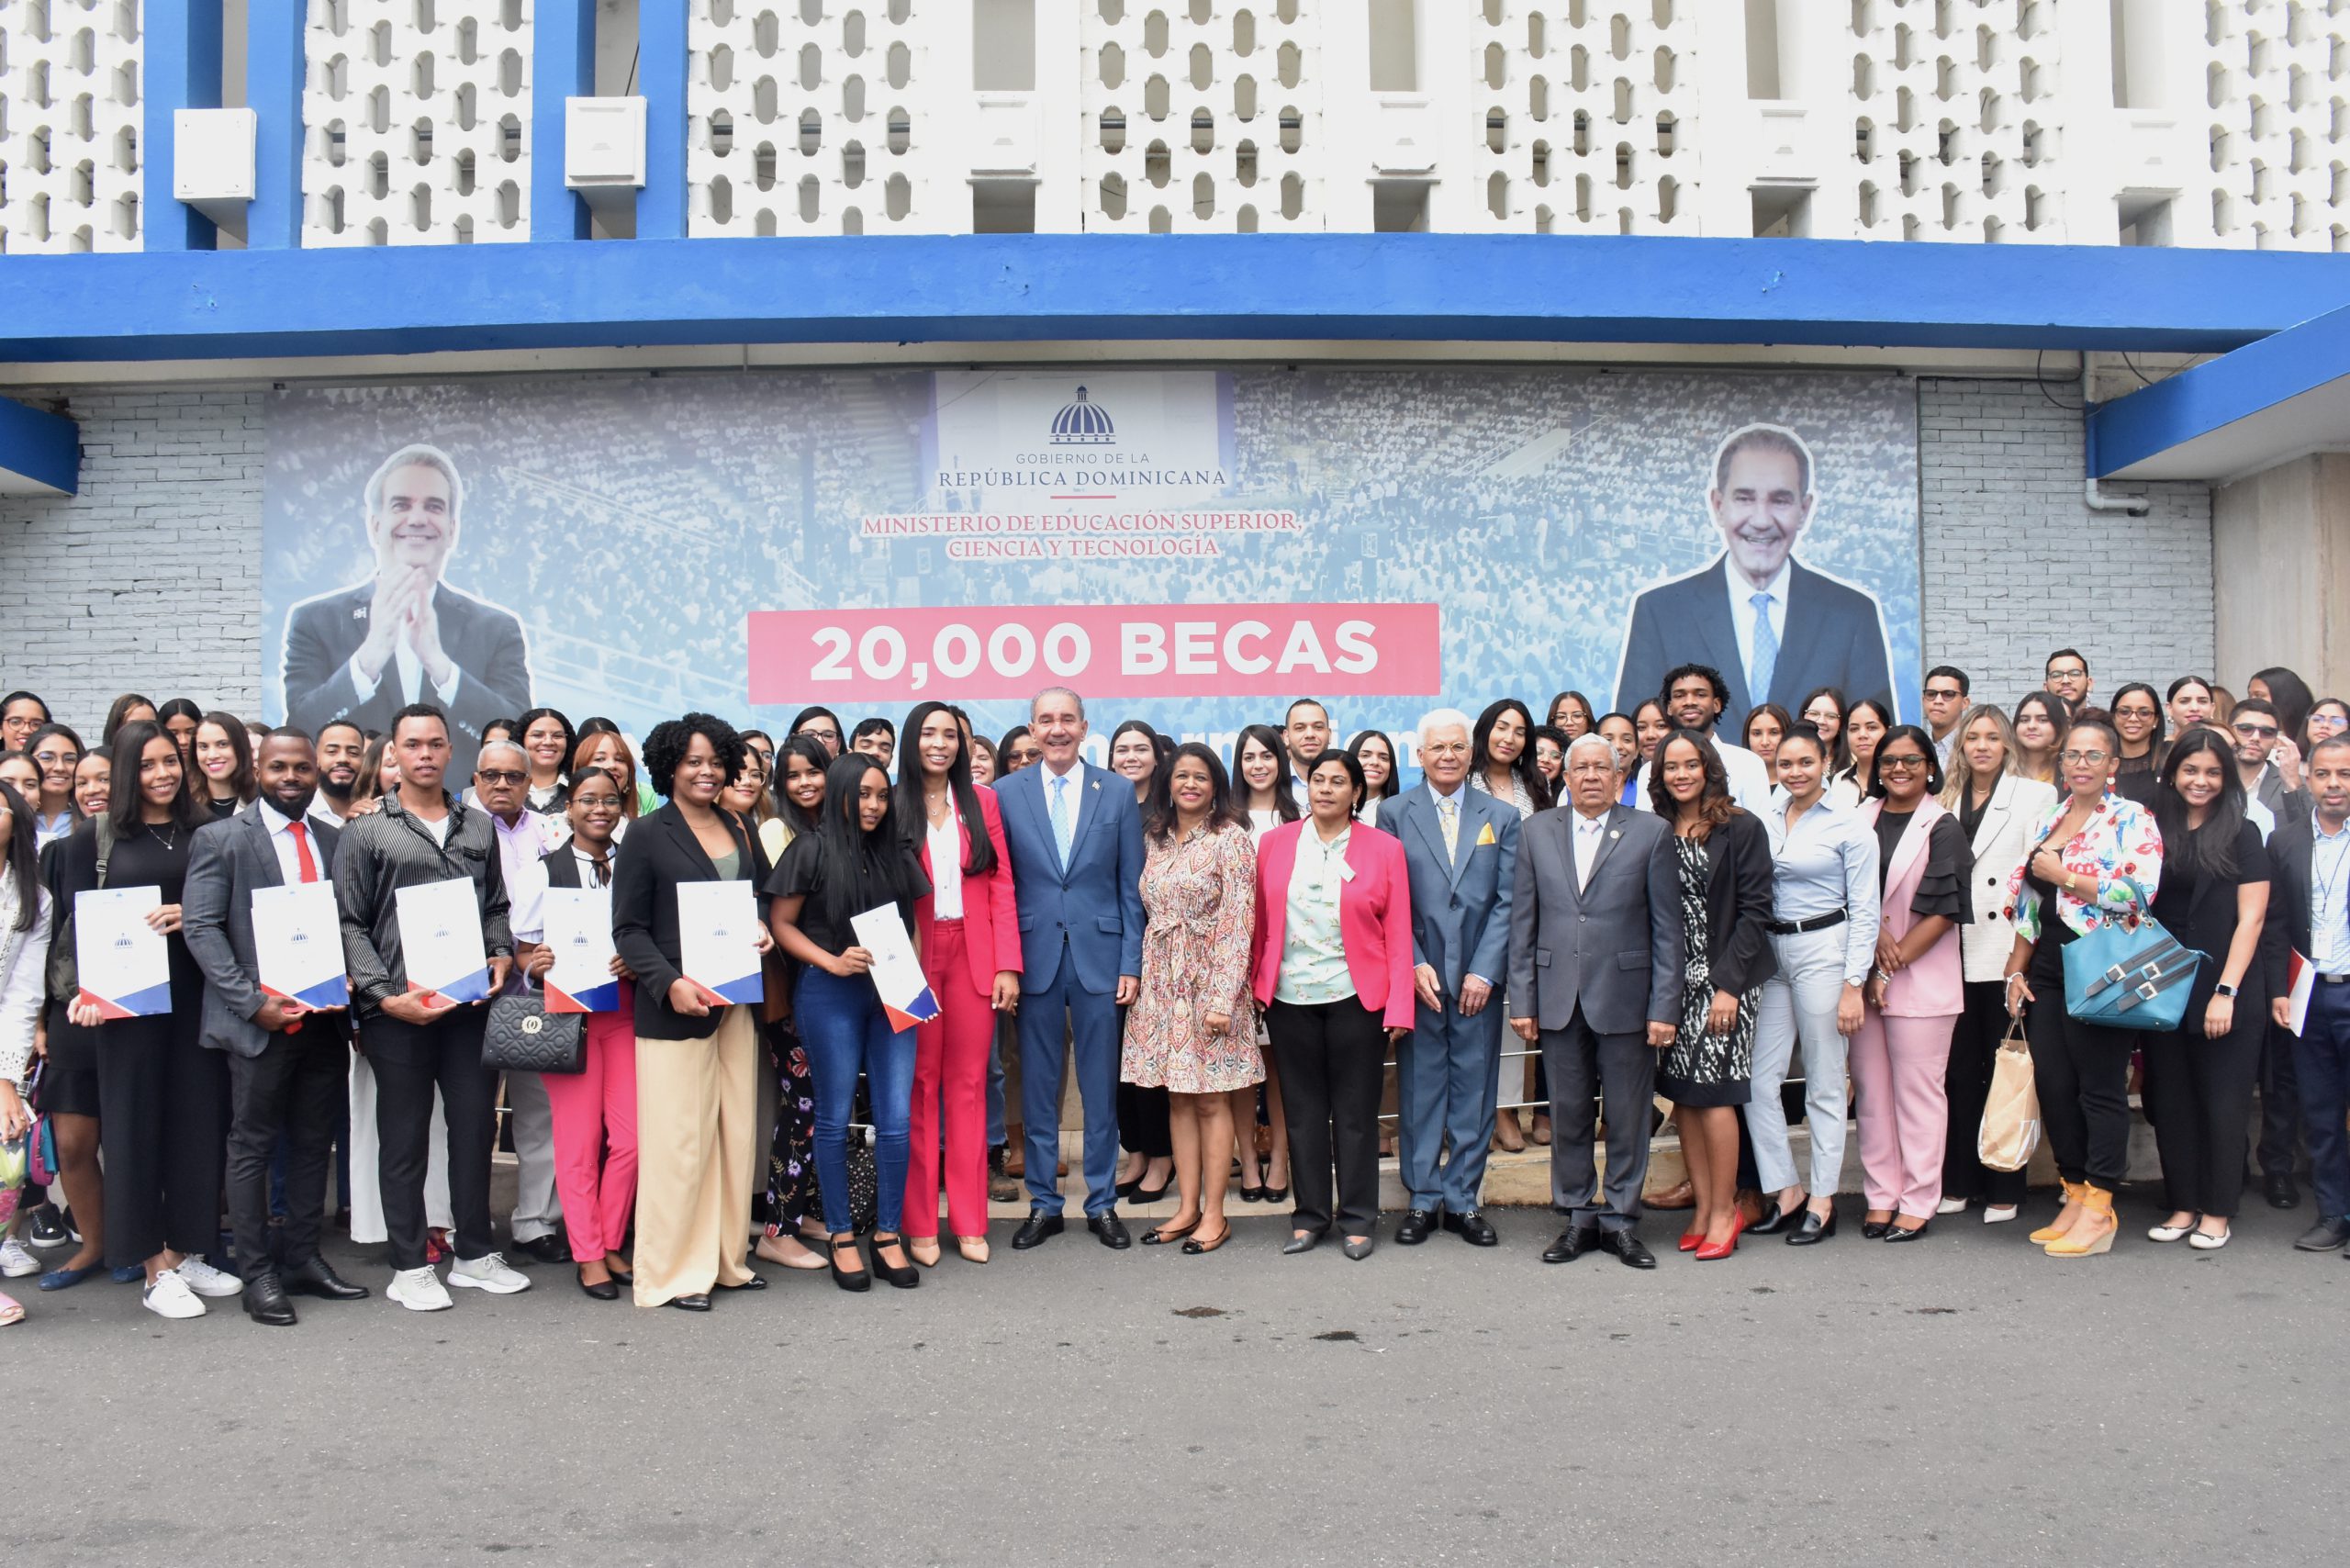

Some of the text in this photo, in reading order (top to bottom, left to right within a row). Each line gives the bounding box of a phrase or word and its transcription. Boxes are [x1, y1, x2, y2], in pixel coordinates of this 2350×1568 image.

[1016, 454, 1150, 464] GOBIERNO DE LA
[938, 467, 1227, 487] REPÚBLICA DOMINICANA
[863, 510, 1303, 534] MINISTERIO DE EDUCACIÓN SUPERIOR,
[948, 536, 1219, 557] CIENCIA Y TECNOLOGÍA
[811, 620, 1379, 690] 20,000 BECAS
